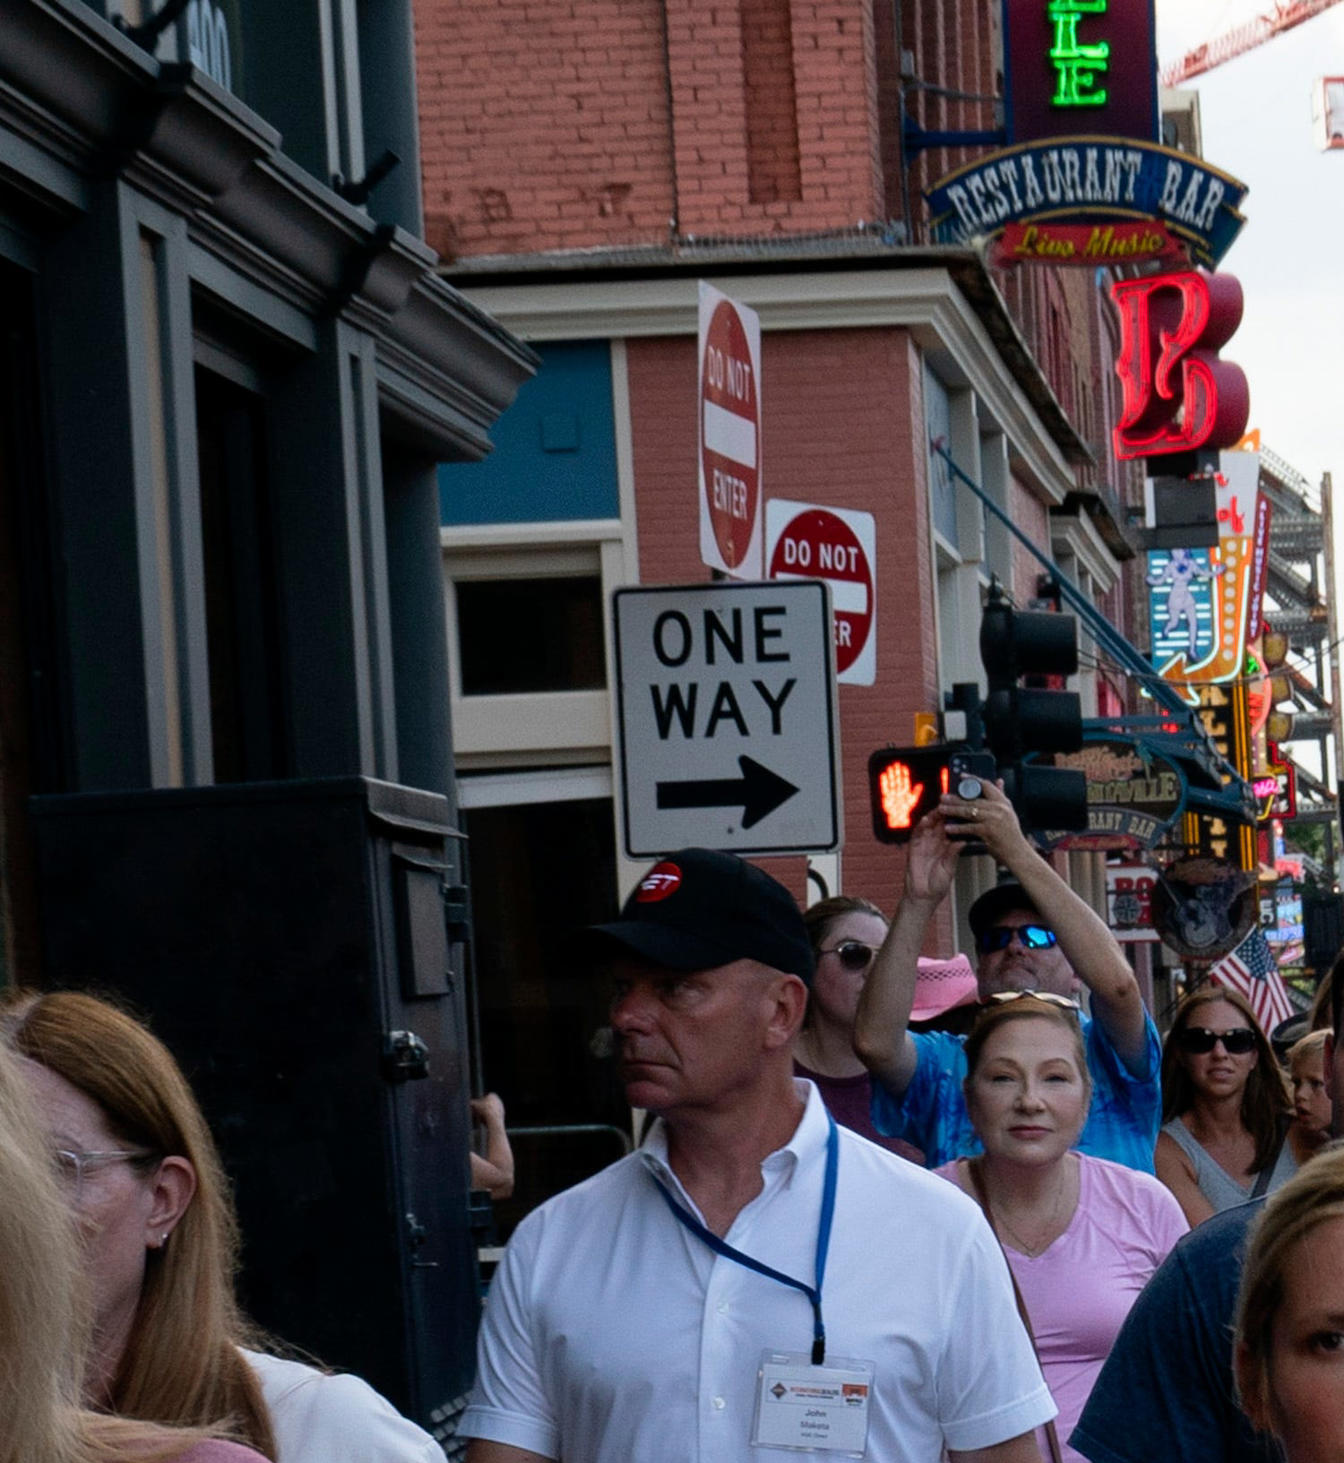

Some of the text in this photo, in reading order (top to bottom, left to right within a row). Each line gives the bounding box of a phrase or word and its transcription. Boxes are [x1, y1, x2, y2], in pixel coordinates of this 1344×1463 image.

[947, 147, 1225, 232] RESTAURANT BAR
[1014, 226, 1165, 257] Live Music
[707, 343, 752, 404] DO NOT
[712, 468, 748, 522] ENTER
[783, 536, 860, 574] DO NOT
[652, 605, 792, 668] ONE
[649, 677, 798, 741] WAY
